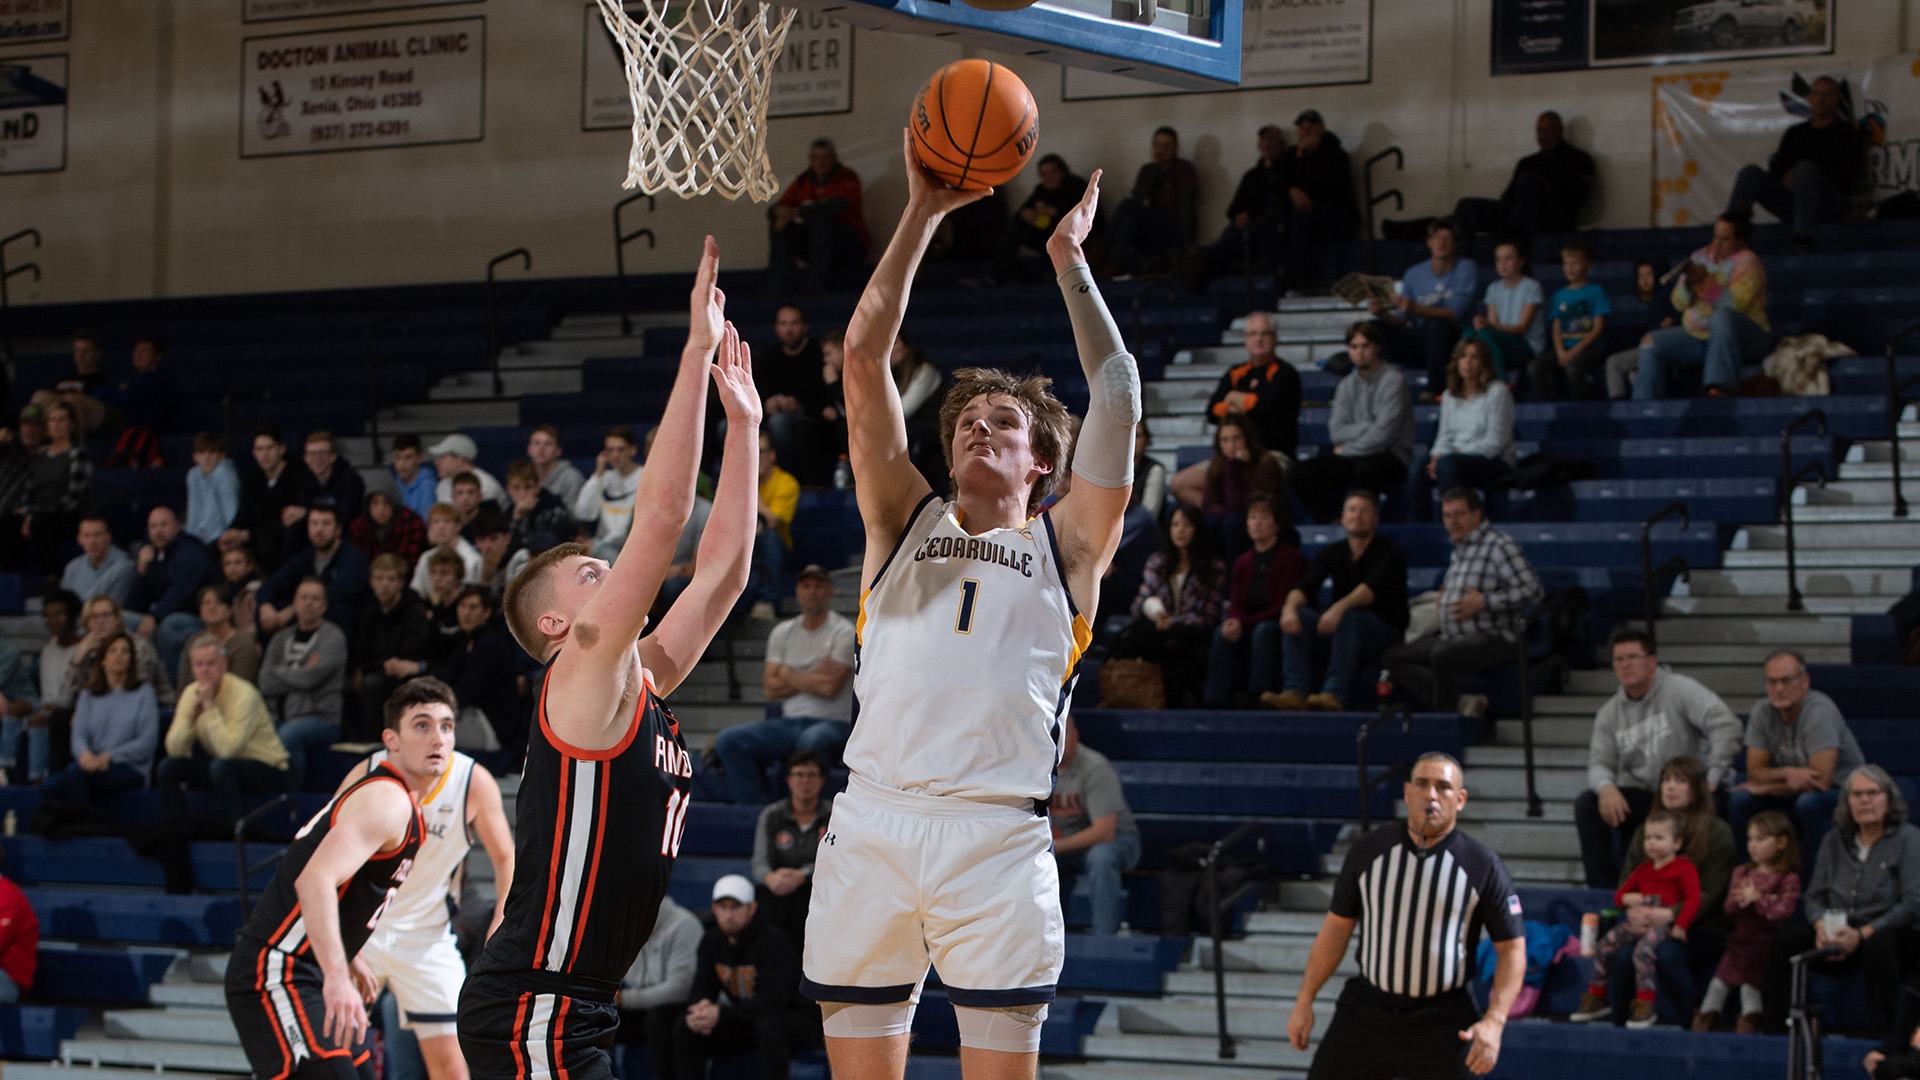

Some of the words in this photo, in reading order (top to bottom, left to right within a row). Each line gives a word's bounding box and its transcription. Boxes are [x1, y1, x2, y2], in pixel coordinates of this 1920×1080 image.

[257, 45, 329, 71] DOCTON
[333, 39, 401, 61] ANIMAL
[406, 33, 469, 56] CLINIC
[776, 38, 841, 73] NER
[330, 72, 376, 91] Kinsey
[377, 67, 414, 86] Road
[345, 95, 378, 112] Ohio
[914, 535, 1034, 578] CEDARVILLE
[955, 577, 981, 635] 1
